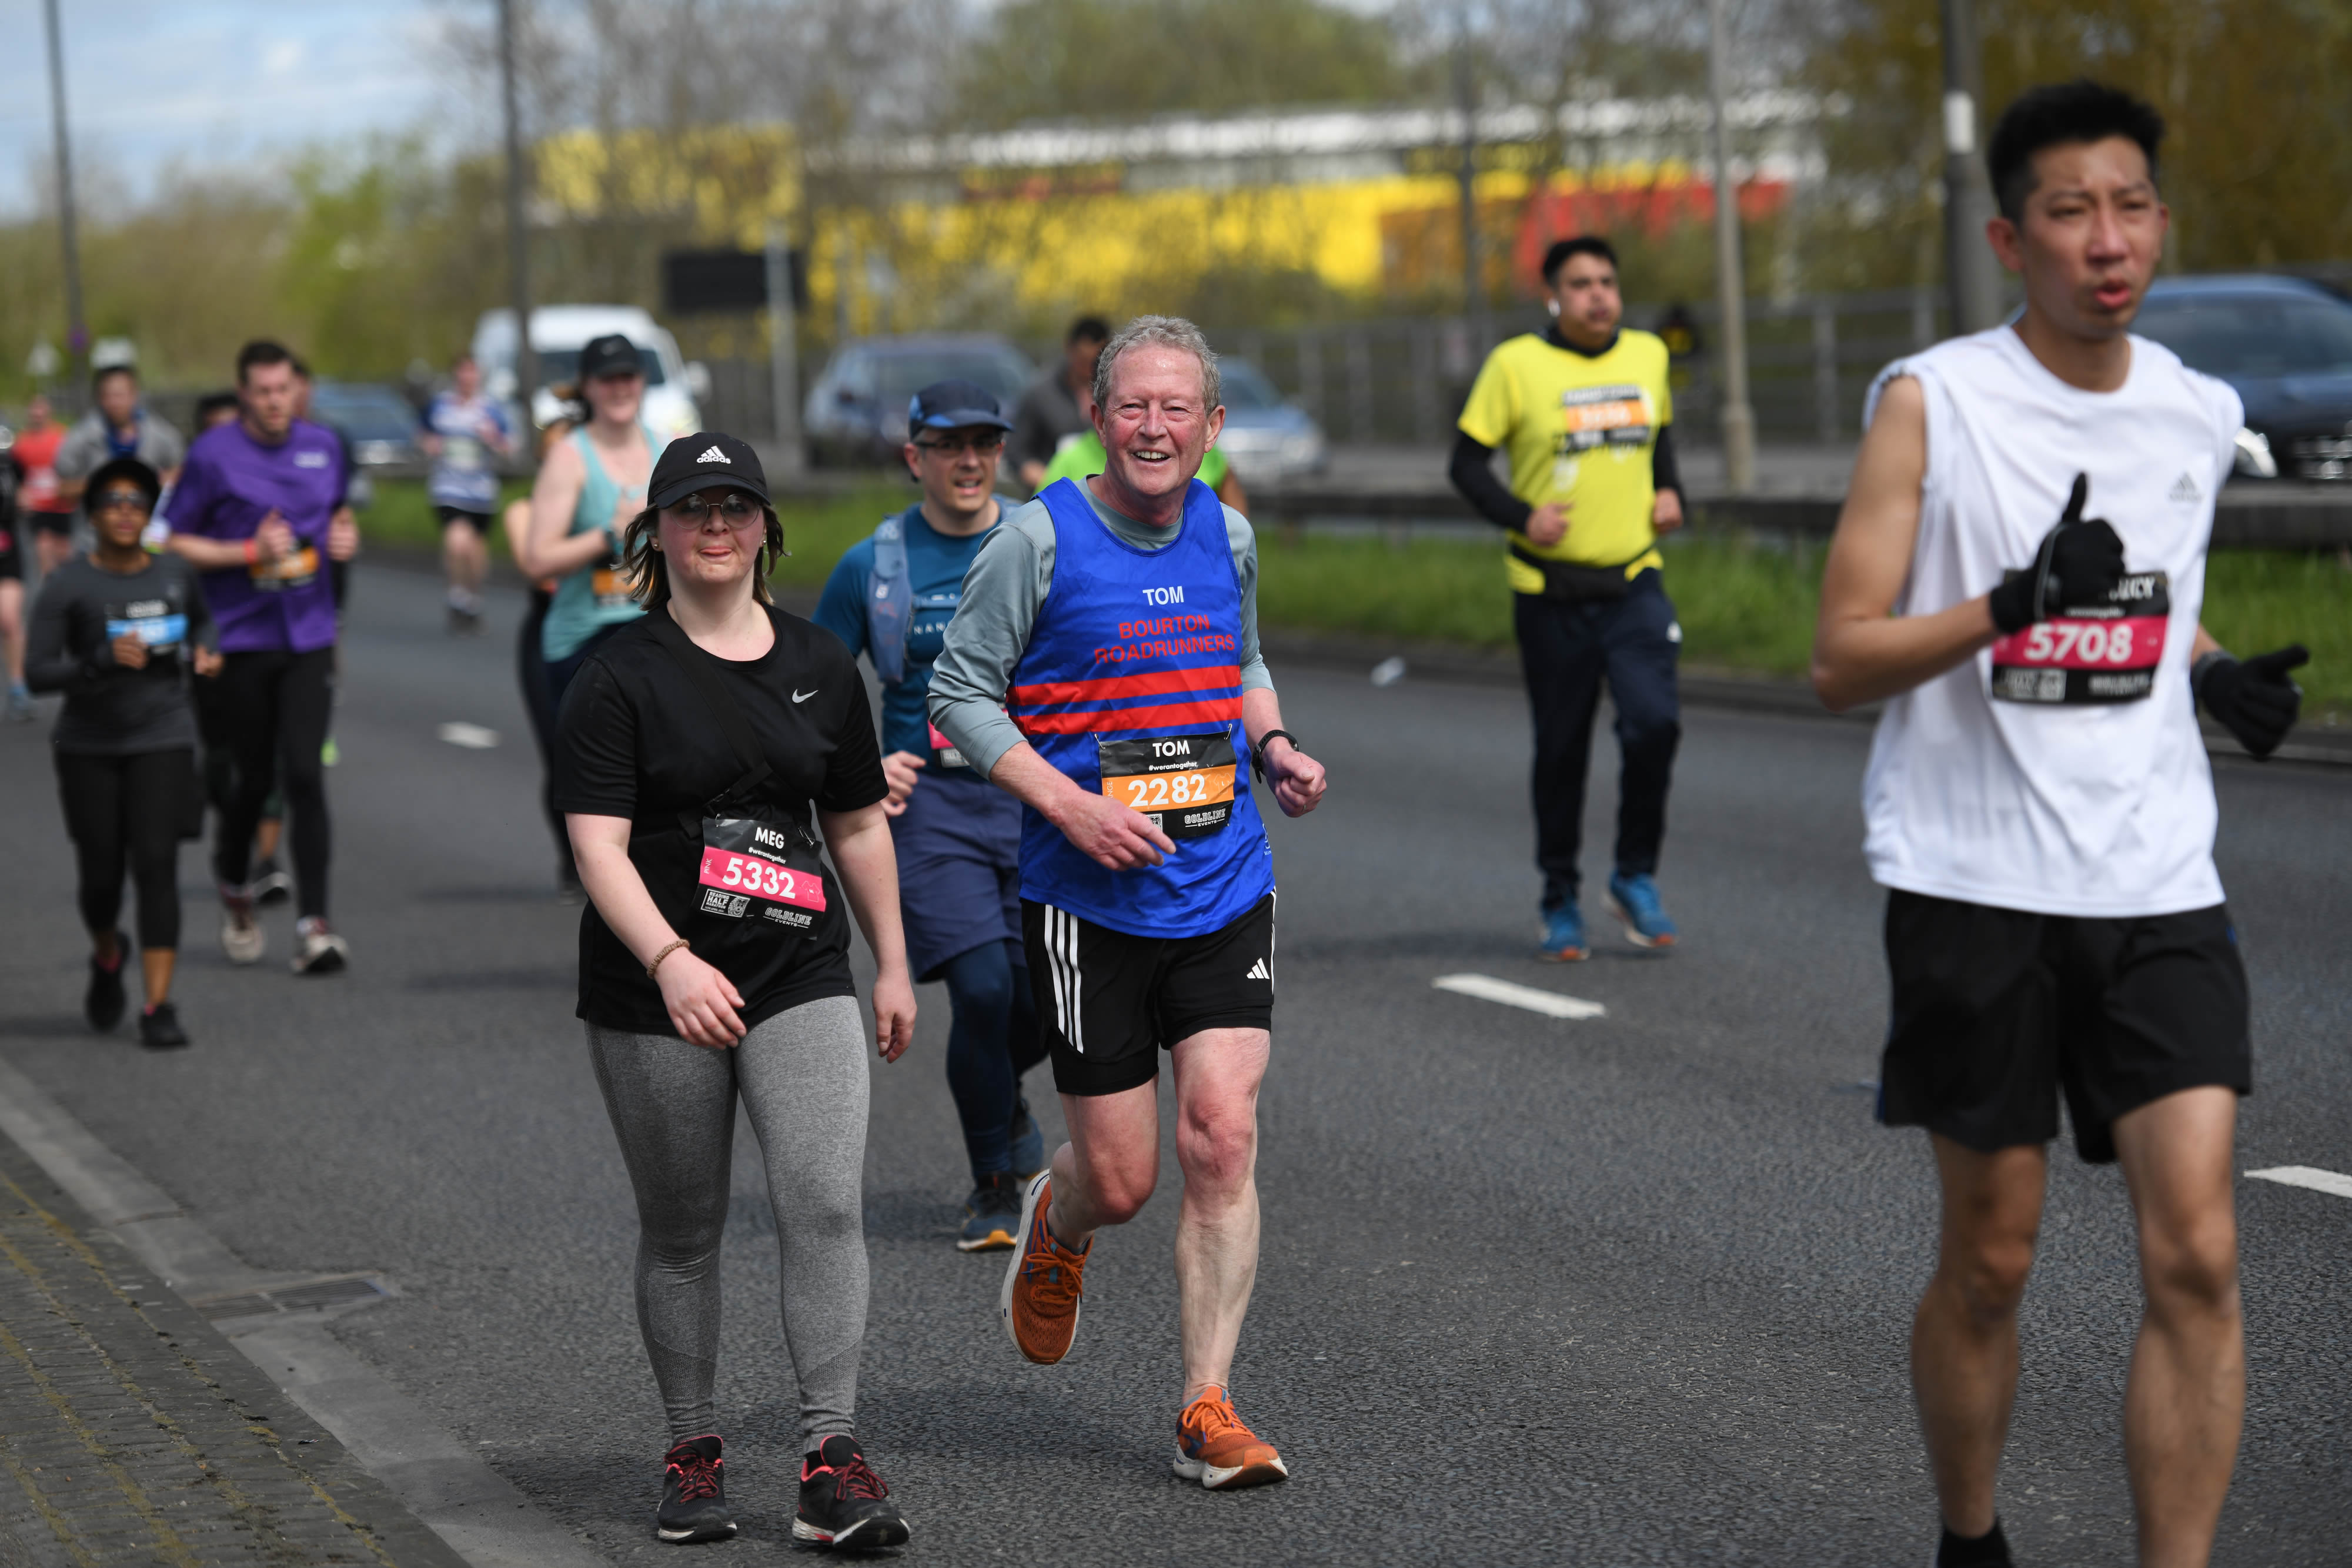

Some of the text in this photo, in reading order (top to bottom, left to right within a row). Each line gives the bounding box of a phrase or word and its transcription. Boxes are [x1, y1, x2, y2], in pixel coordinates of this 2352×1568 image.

[696, 456, 731, 464] adidas
[1142, 586, 1184, 606] TOM
[1118, 614, 1210, 639] BOURTON
[1094, 634, 1235, 664] ROADRUNNERS
[2023, 623, 2133, 663] 5708
[1152, 740, 1190, 757] TOM
[1148, 761, 1197, 771] #werantogether
[1128, 774, 1207, 807] 2282
[1184, 808, 1226, 824] GOLDLINE
[754, 827, 784, 849] MEG
[748, 847, 786, 864] #werantogether
[703, 858, 713, 874] PINK
[722, 857, 796, 899] 5332
[707, 895, 729, 905] HALF
[709, 891, 730, 900] READING
[764, 907, 813, 925] GOLDLINE
[774, 918, 798, 927] EVENTS
